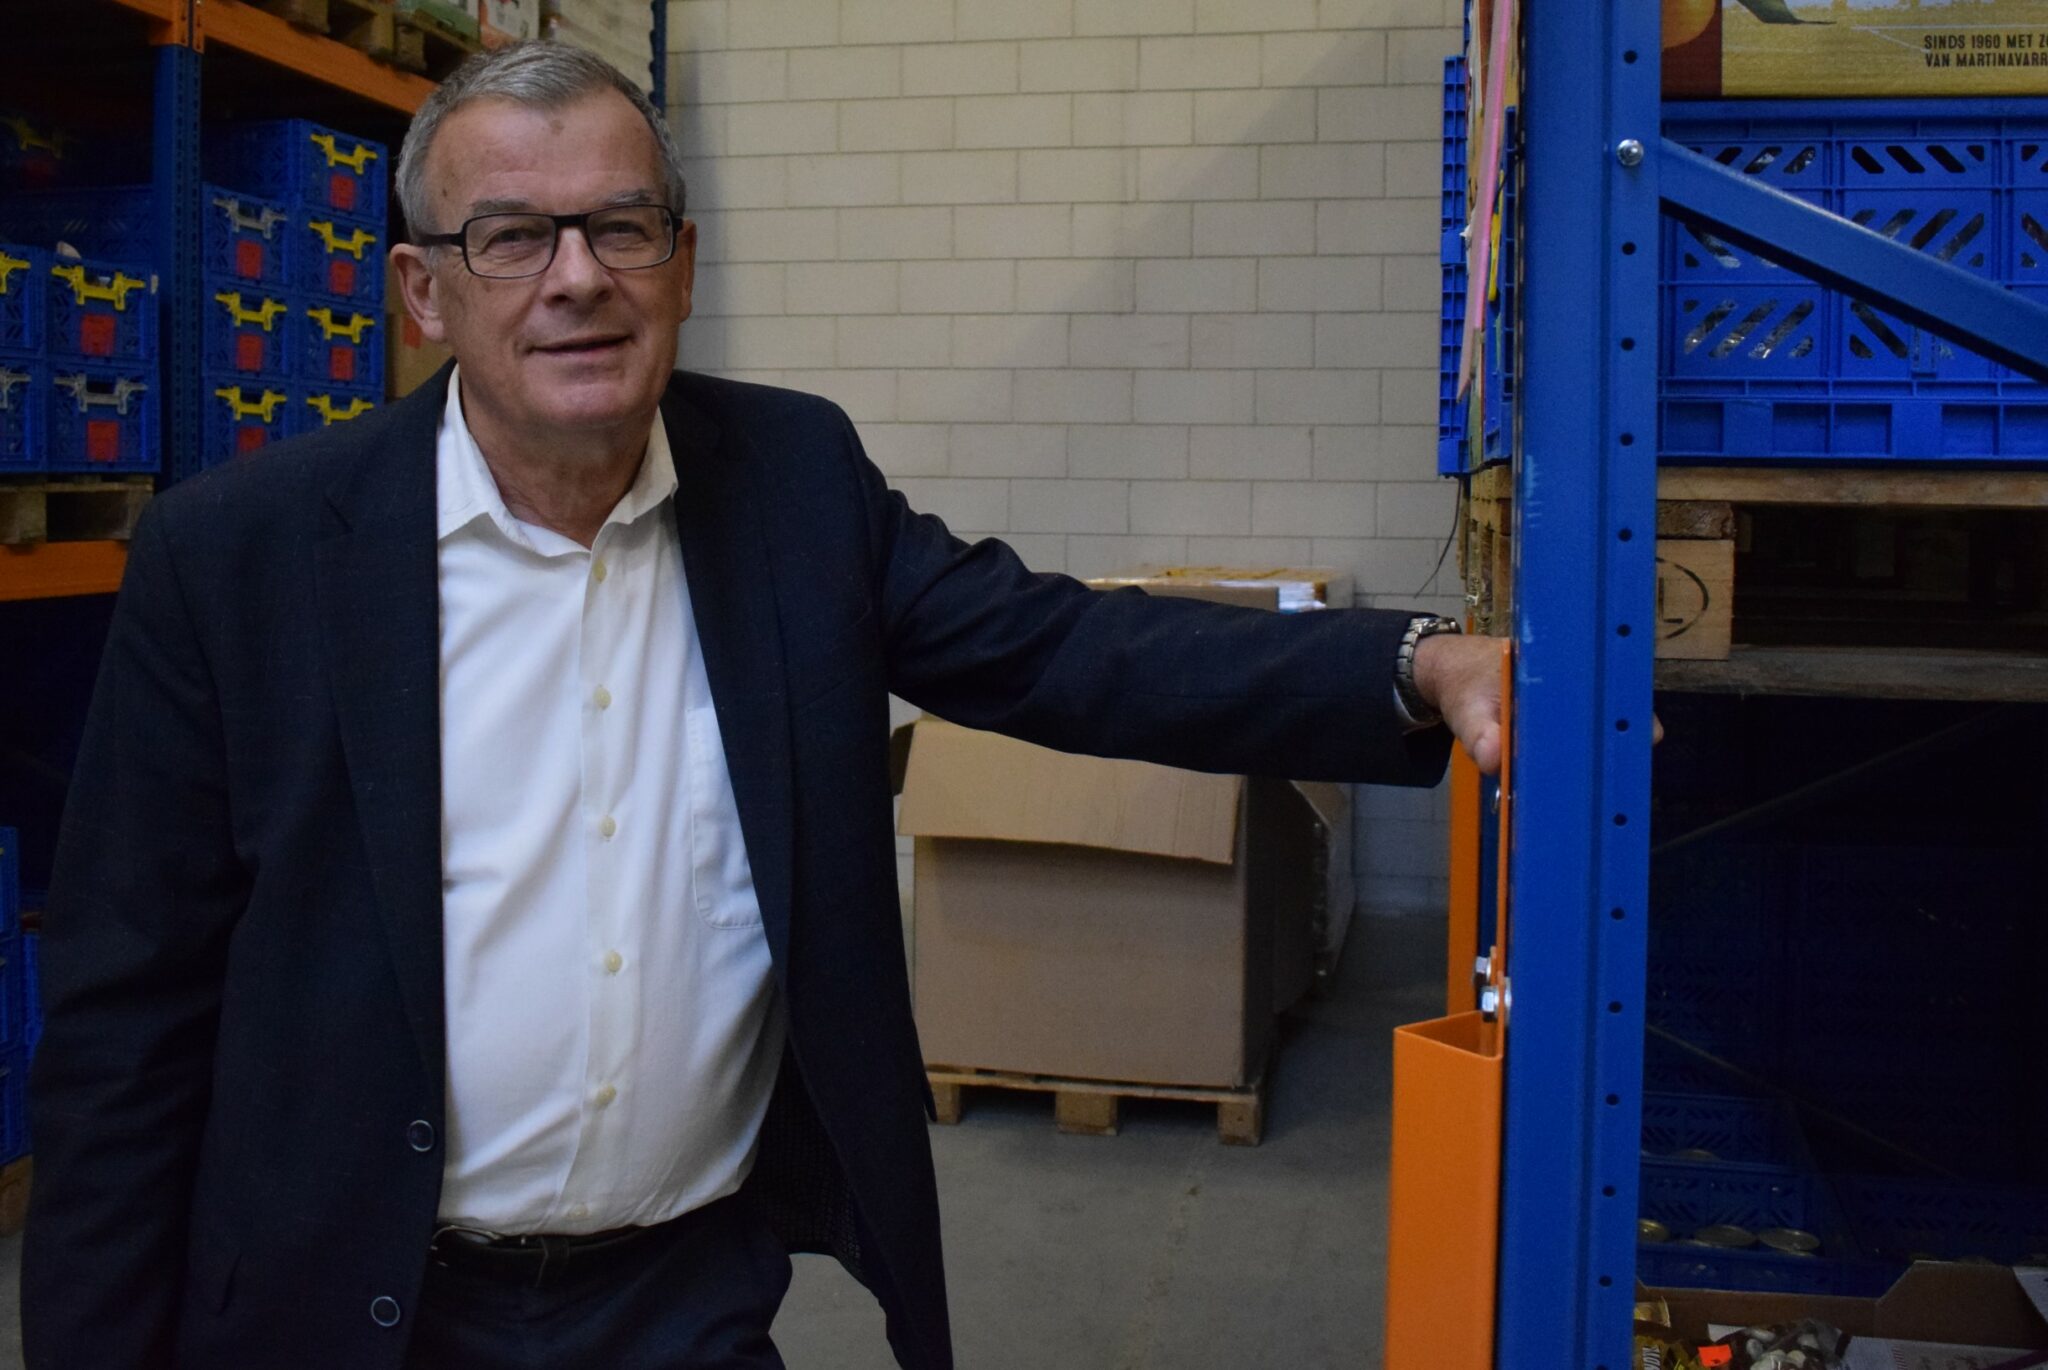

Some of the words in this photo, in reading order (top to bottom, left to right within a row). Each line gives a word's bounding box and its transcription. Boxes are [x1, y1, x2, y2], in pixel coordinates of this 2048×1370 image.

[1924, 34, 1966, 49] SINDS
[1971, 34, 2001, 49] 1960
[2006, 34, 2033, 48] MET
[2039, 34, 2048, 48] Z
[1925, 53, 1950, 67] VAN
